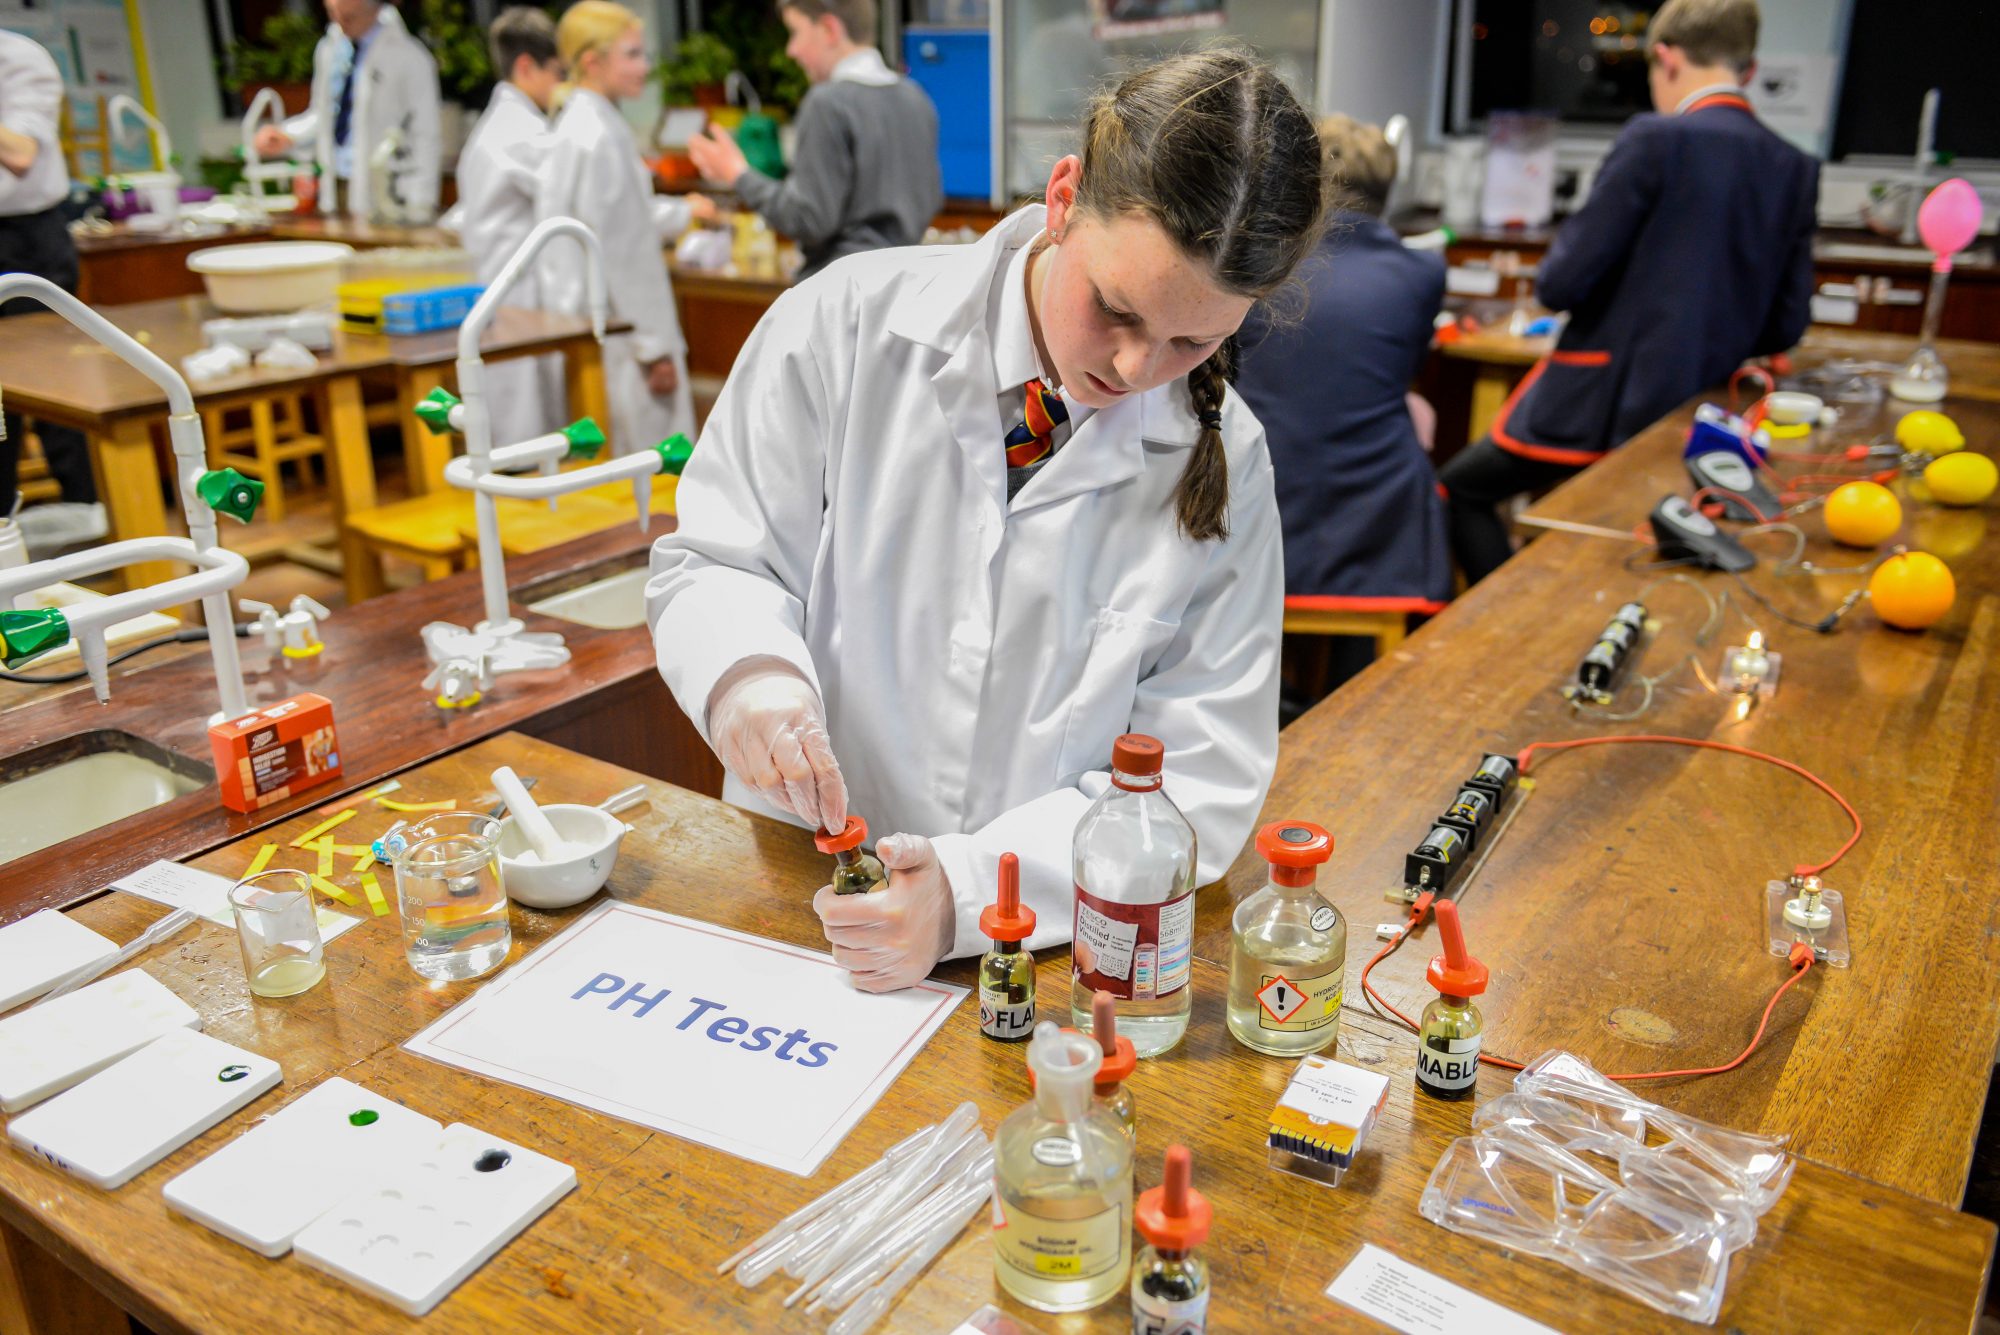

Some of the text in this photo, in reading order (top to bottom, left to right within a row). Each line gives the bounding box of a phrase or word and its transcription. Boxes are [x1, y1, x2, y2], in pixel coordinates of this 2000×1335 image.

[407, 895, 423, 906] 200
[412, 917, 426, 927] 150
[1079, 915, 1110, 941] Distilled
[415, 936, 429, 947] 100
[1079, 924, 1107, 949] Vinegar
[570, 972, 839, 1068] PH Tests
[996, 1003, 1035, 1029] FLA
[1417, 1047, 1480, 1080] MABLE
